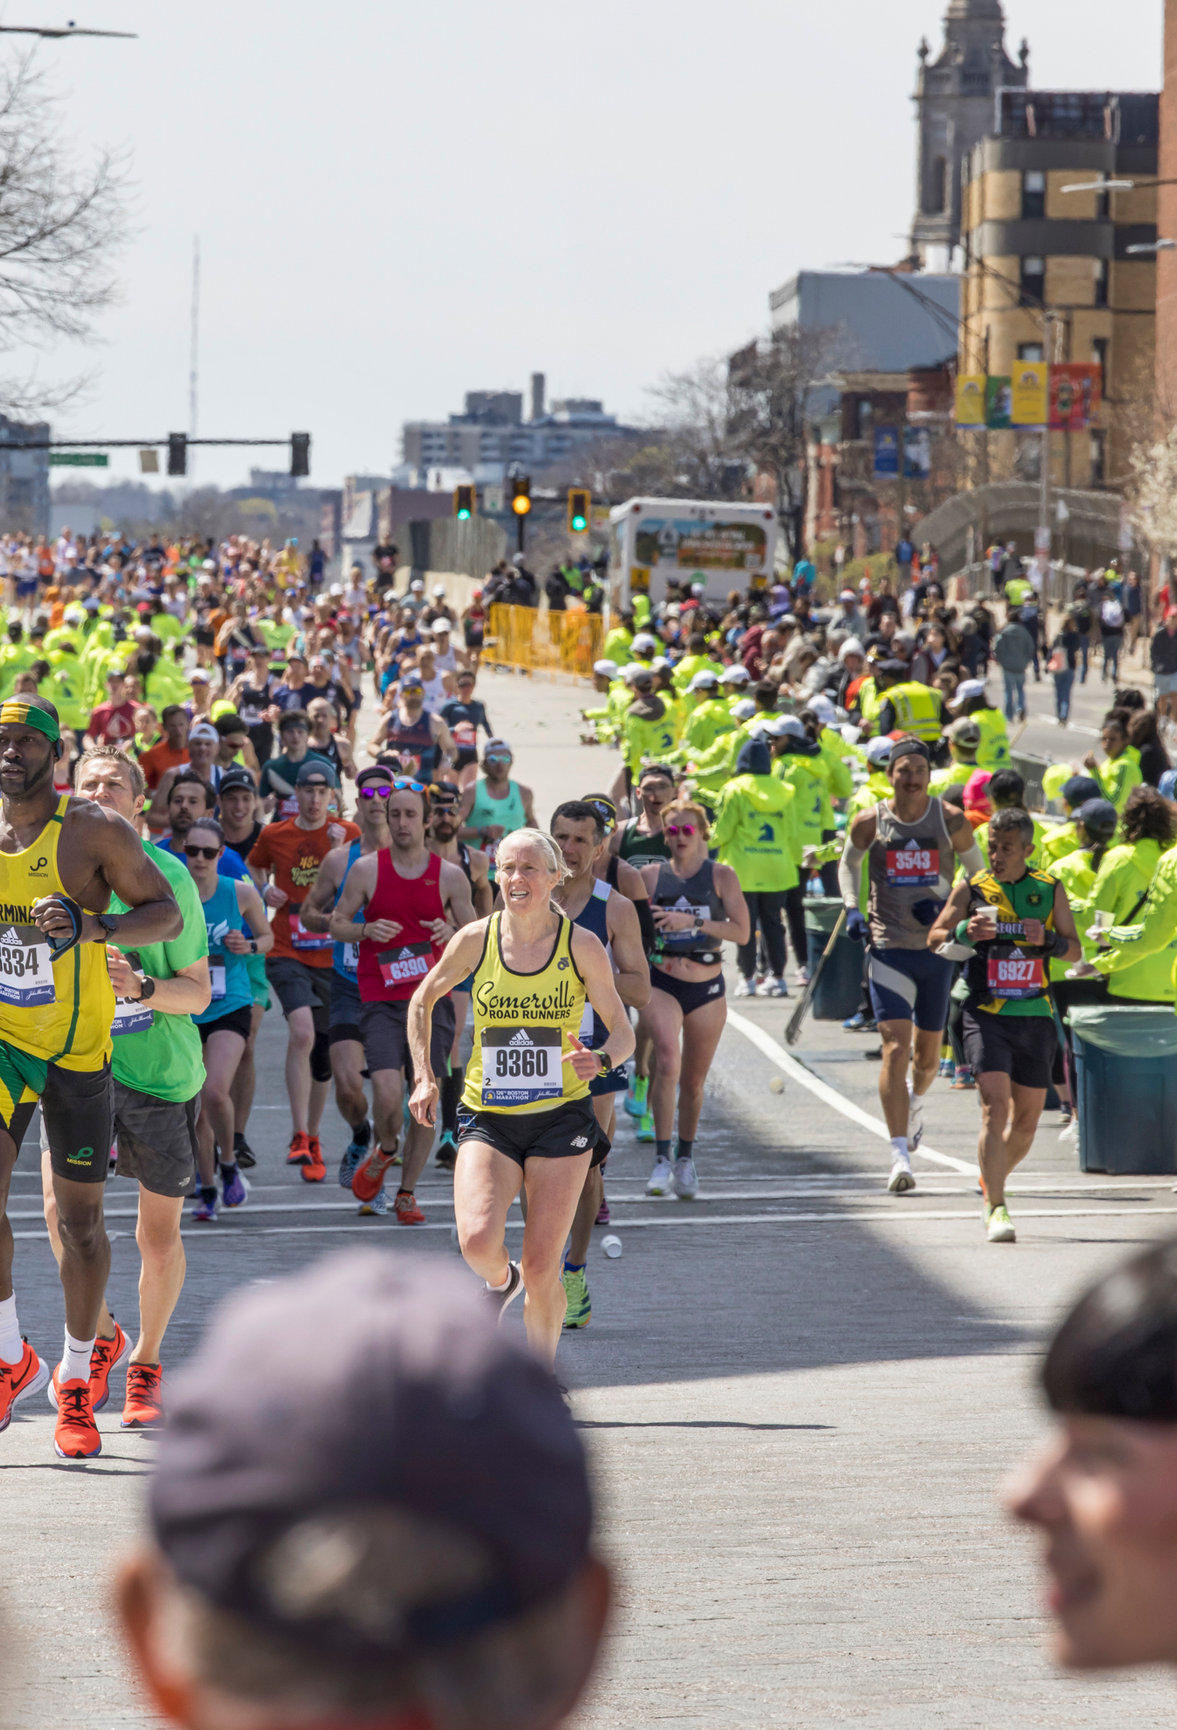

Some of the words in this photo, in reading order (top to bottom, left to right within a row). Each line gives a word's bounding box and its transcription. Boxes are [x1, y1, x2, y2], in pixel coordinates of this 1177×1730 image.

[895, 851, 930, 869] 3543
[0, 937, 23, 945] adidas
[390, 956, 429, 980] 6390
[998, 961, 1035, 981] 6927
[477, 981, 575, 1016] Somerville
[489, 1010, 519, 1019] ROAD
[522, 1009, 571, 1019] RUNNERS
[496, 1049, 548, 1077] 9360
[485, 1077, 491, 1086] 2
[66, 1158, 92, 1166] MISSION
